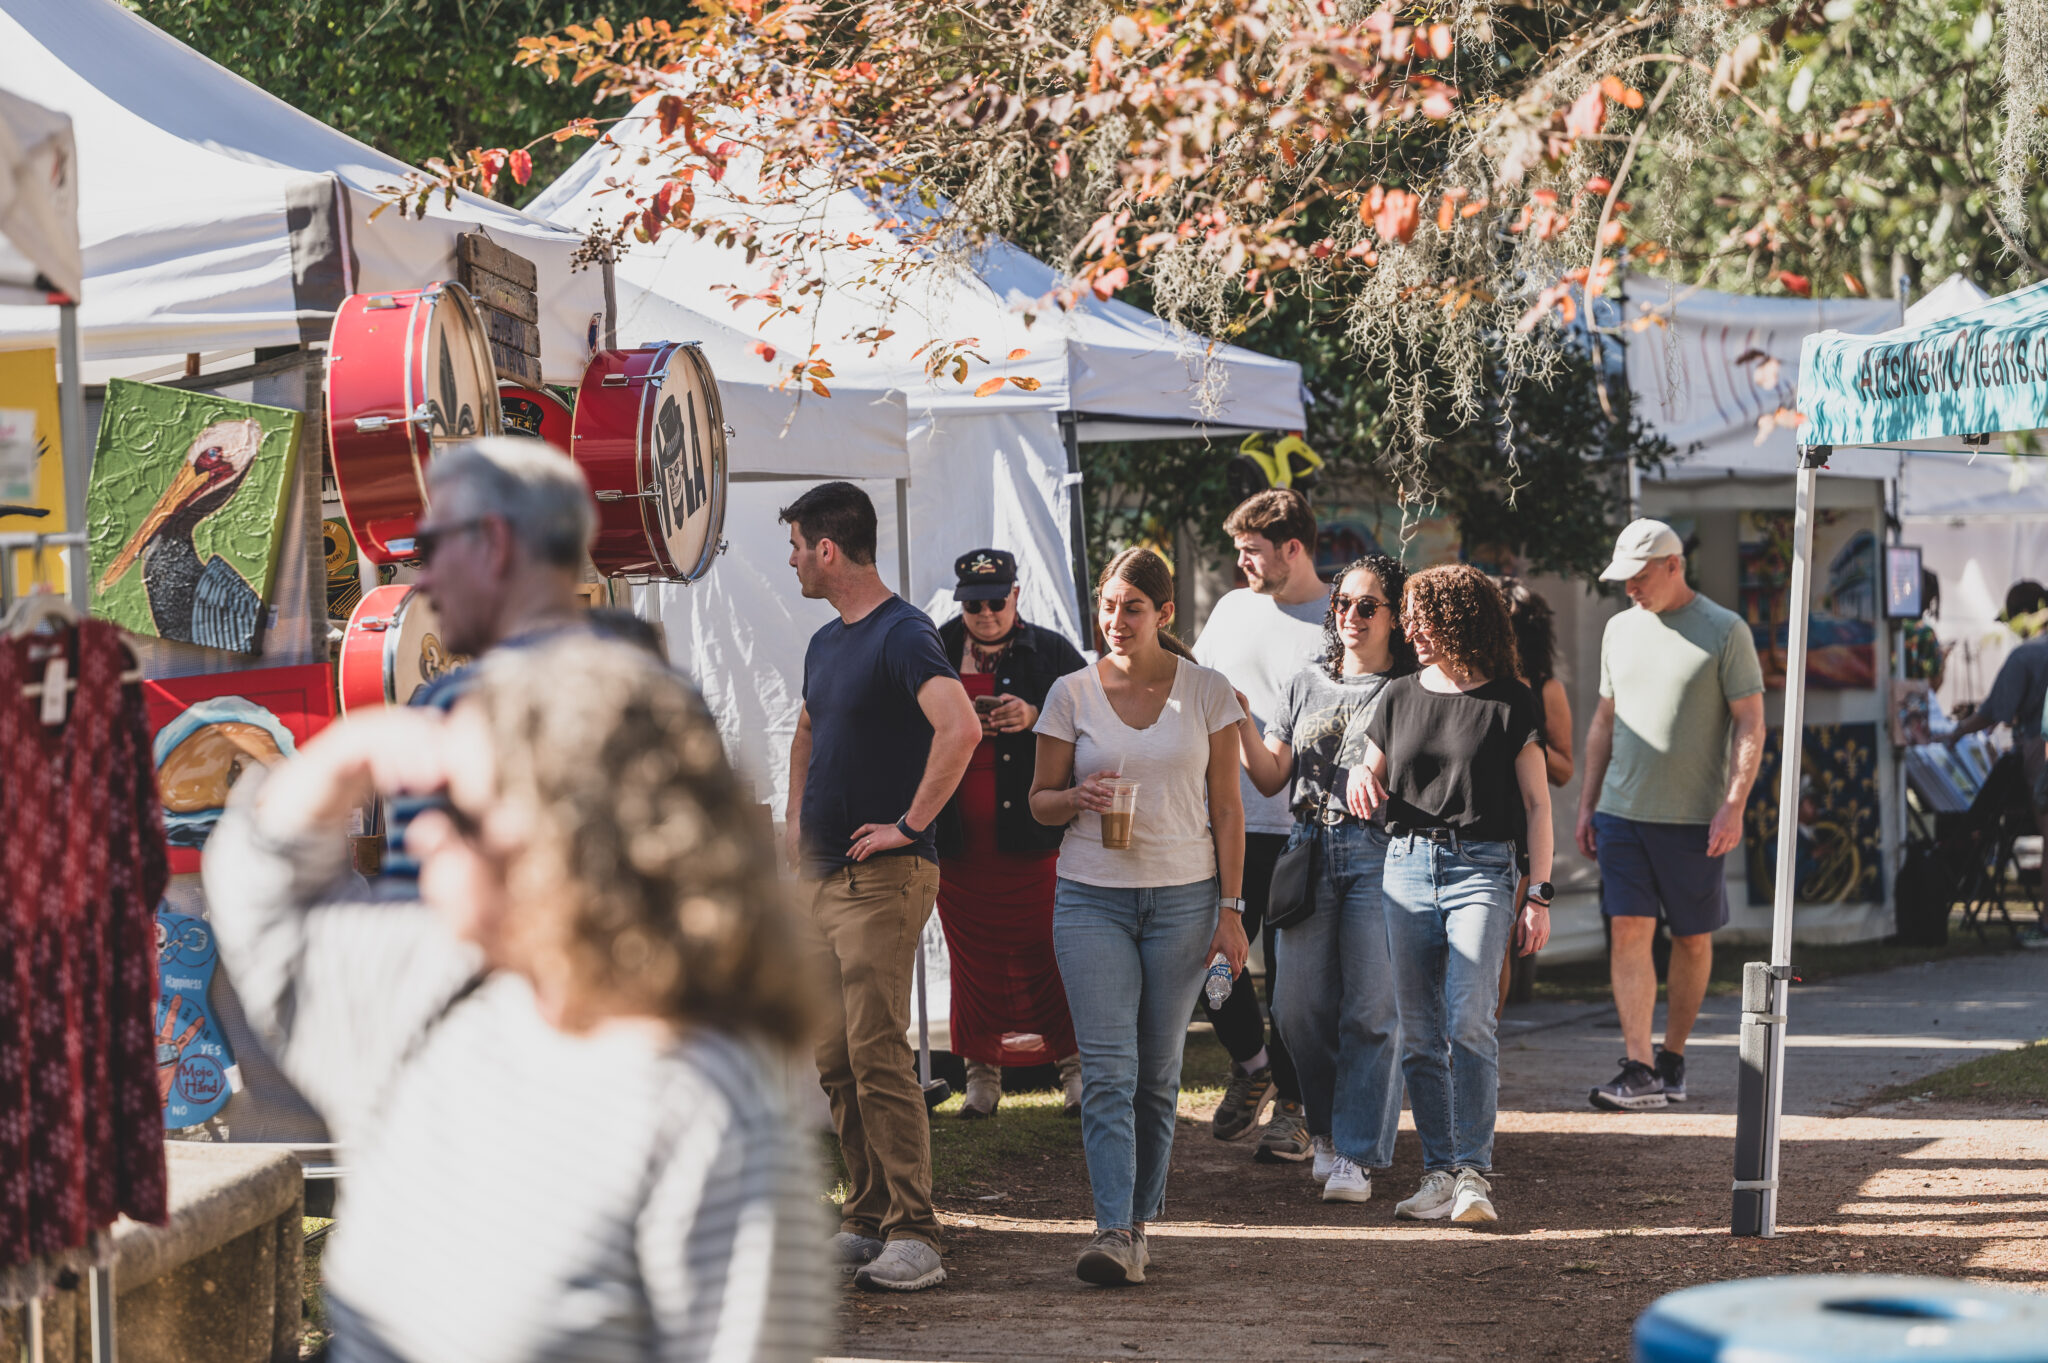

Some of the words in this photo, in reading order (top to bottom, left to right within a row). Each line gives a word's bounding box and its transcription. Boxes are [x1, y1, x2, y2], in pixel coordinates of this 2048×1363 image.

[165, 974, 202, 990] Happiness
[201, 1043, 222, 1056] YES
[179, 1062, 213, 1083] Mojo
[185, 1079, 217, 1095] Hand
[172, 1105, 188, 1115] NO
